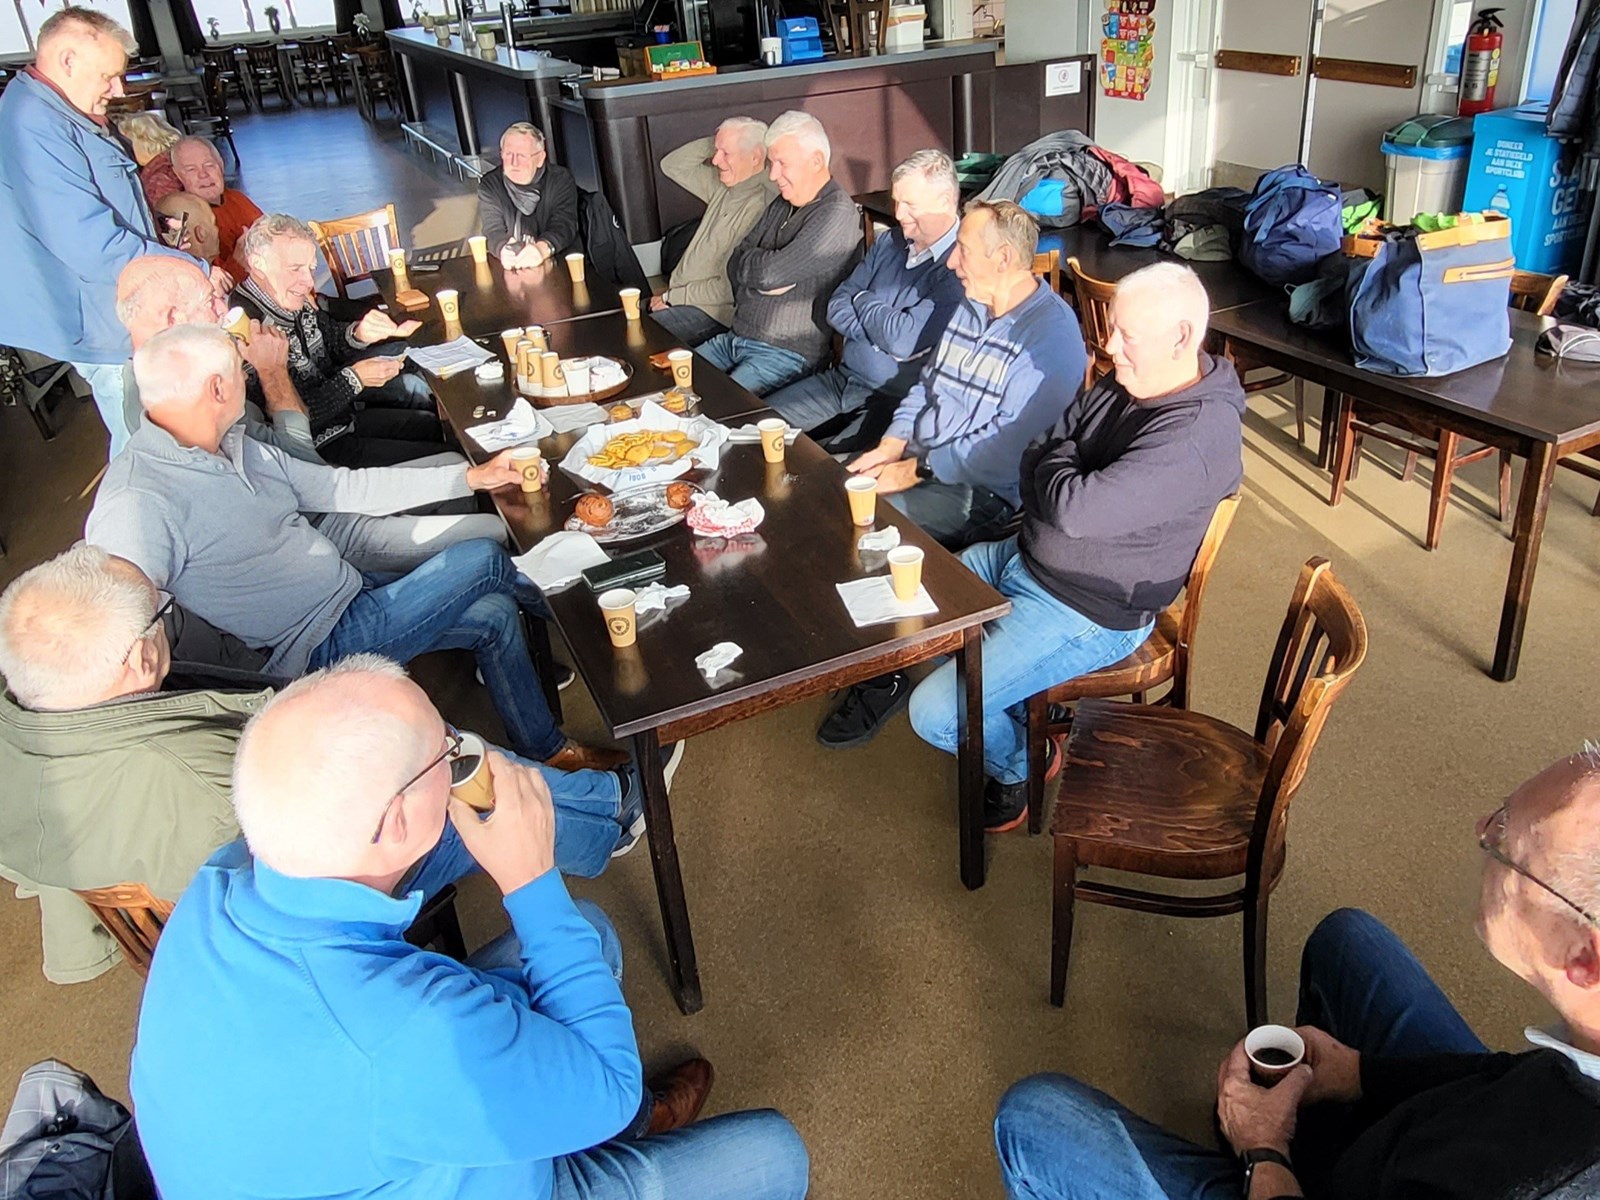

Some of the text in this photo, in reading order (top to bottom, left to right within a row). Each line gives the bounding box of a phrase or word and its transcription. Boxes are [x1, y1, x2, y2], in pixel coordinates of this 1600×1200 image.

[1497, 140, 1524, 150] DONEER
[1485, 148, 1533, 161] JE STATIEGELD
[1491, 158, 1523, 169] AAN DEZE
